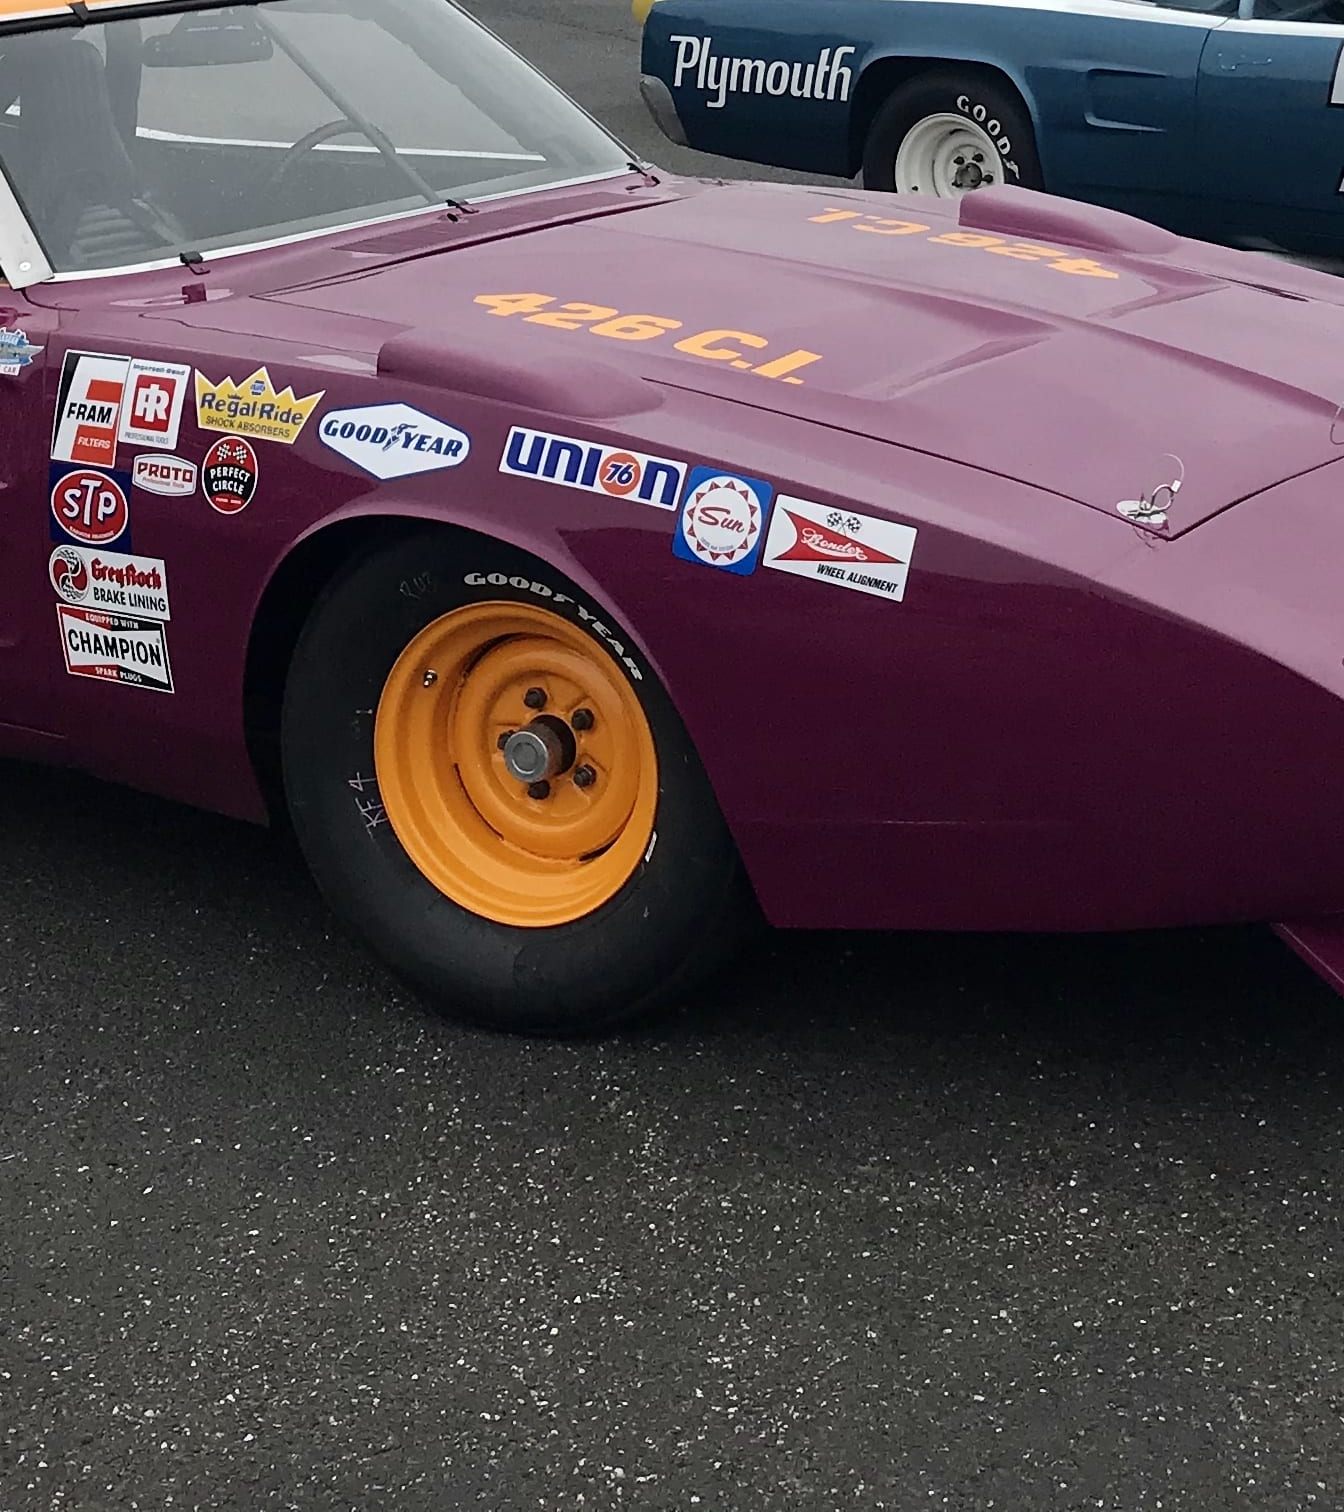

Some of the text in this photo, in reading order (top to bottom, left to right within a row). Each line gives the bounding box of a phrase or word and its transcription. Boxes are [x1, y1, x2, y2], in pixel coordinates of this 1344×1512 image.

[669, 34, 856, 109] Plymouth
[473, 292, 823, 385] 426 C.I.
[66, 402, 113, 424] FRAM
[205, 415, 291, 438] SHOCK ABSORBERS
[77, 436, 111, 450] FILTERS
[137, 462, 193, 483] PROTO
[210, 466, 251, 483] PERFECT
[602, 462, 634, 485] 76
[212, 479, 245, 495] CIRCLE
[62, 478, 117, 526] STP
[697, 506, 745, 534] Sun
[816, 563, 898, 594] WHEEL ALIGNMENT
[93, 587, 167, 613] BRAKE LINING
[85, 612, 139, 630] EQUIPPED WITH
[67, 628, 162, 667] CHAMPION
[94, 666, 143, 684] SPARK PLUGS
